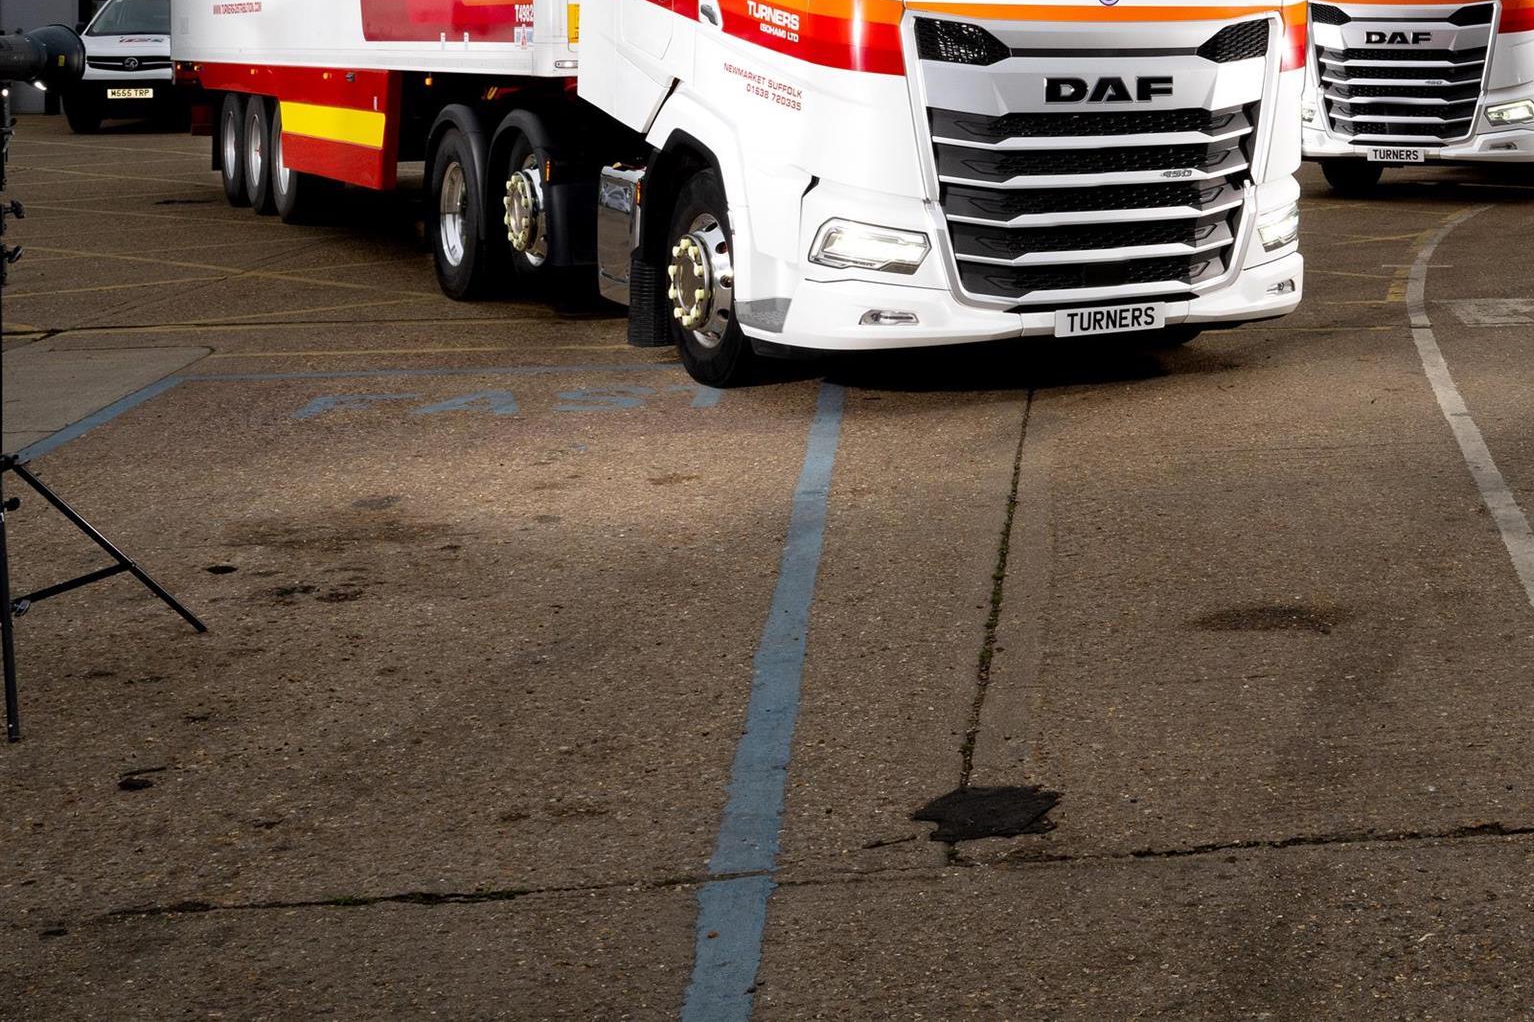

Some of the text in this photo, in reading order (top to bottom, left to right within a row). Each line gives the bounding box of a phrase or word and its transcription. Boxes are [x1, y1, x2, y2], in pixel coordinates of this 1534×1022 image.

[747, 0, 801, 31] TURNERS
[787, 32, 799, 43] LTD
[1365, 31, 1433, 45] DAF
[134, 89, 150, 97] TRP
[723, 62, 804, 99] NEWMARKET SUFFOLK
[1044, 76, 1174, 104] DAF
[746, 83, 802, 111] 01638 720335
[1372, 149, 1419, 161] TURNERS
[1066, 306, 1155, 333] TURNERS
